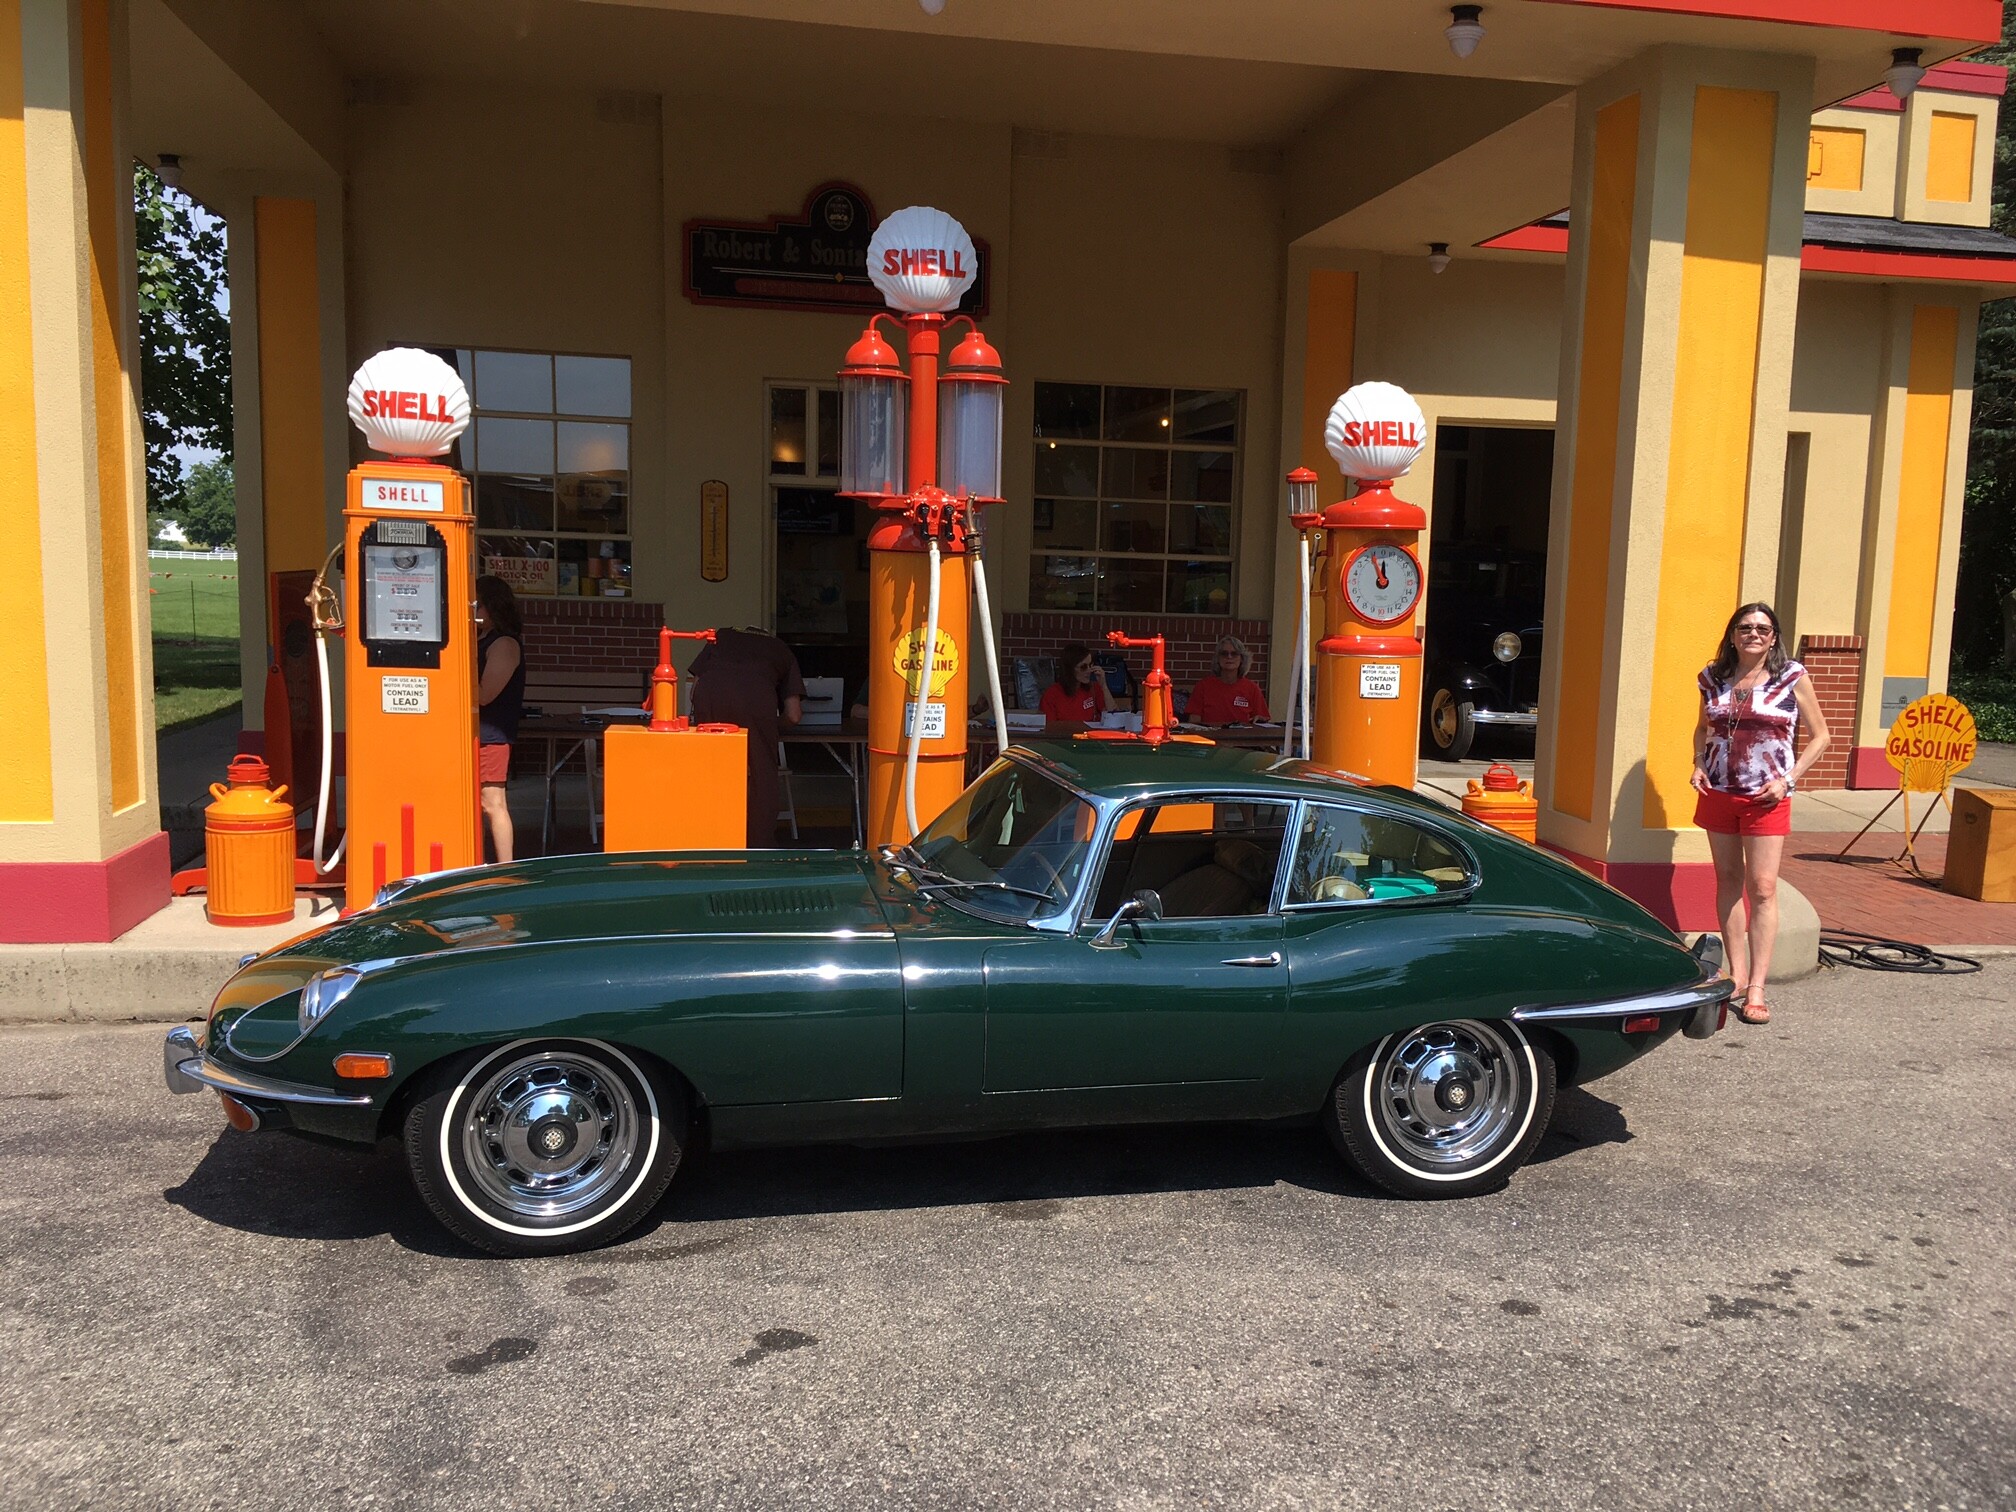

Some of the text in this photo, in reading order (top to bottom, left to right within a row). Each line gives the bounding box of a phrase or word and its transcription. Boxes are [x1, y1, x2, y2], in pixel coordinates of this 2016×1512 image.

[702, 230, 772, 262] Robert
[783, 236, 801, 263] &
[882, 248, 967, 279] SHELL
[362, 389, 455, 424] SHELL
[1341, 420, 1419, 448] SHELL
[377, 486, 429, 503] SHELL
[489, 559, 550, 572] SHELL X-100
[495, 571, 545, 581] MOTOR OIL
[909, 641, 946, 656] SHLL
[900, 659, 954, 672] GASLINE
[1369, 683, 1392, 691] LEAD
[392, 697, 419, 706] LEAD
[1904, 705, 1965, 734] SHELL
[1889, 737, 1972, 763] GASOLINE
